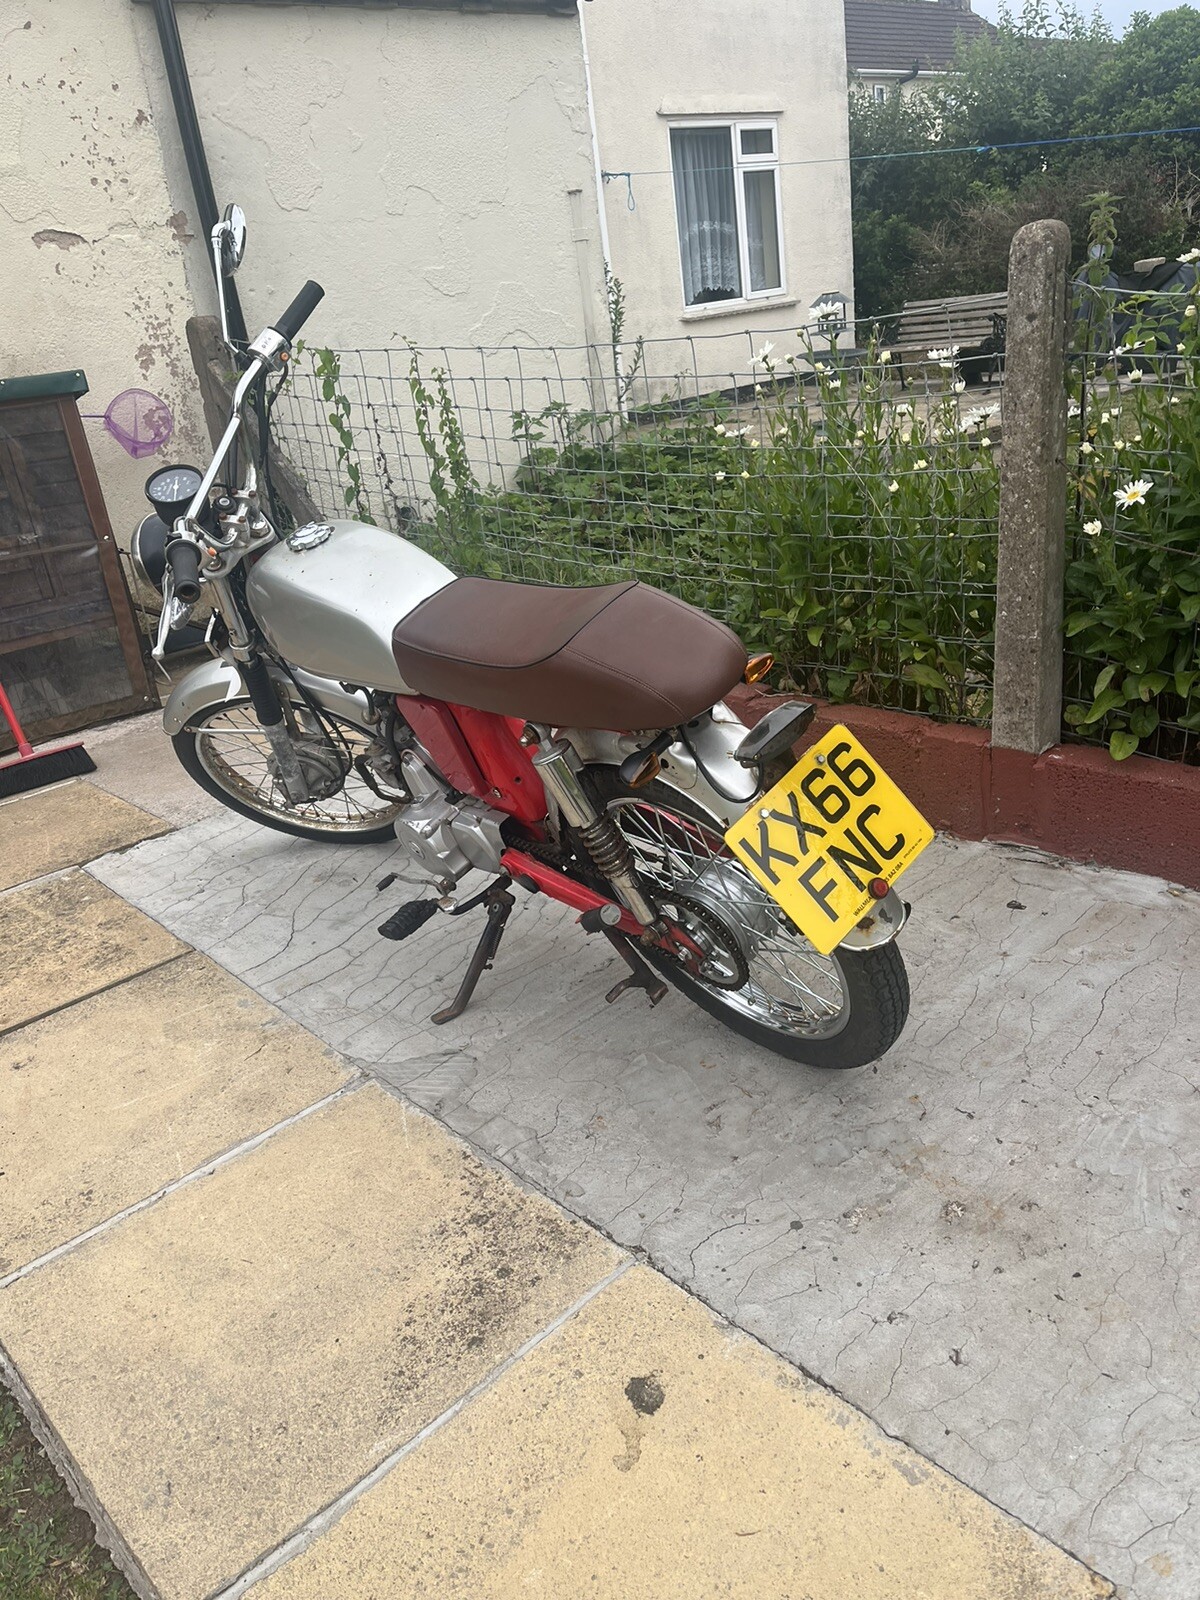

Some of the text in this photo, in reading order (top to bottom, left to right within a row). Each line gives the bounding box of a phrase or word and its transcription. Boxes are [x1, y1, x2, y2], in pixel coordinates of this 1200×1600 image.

[738, 742, 876, 885] KX66
[798, 804, 905, 922] FNC
[853, 896, 873, 916] WALLMEA
